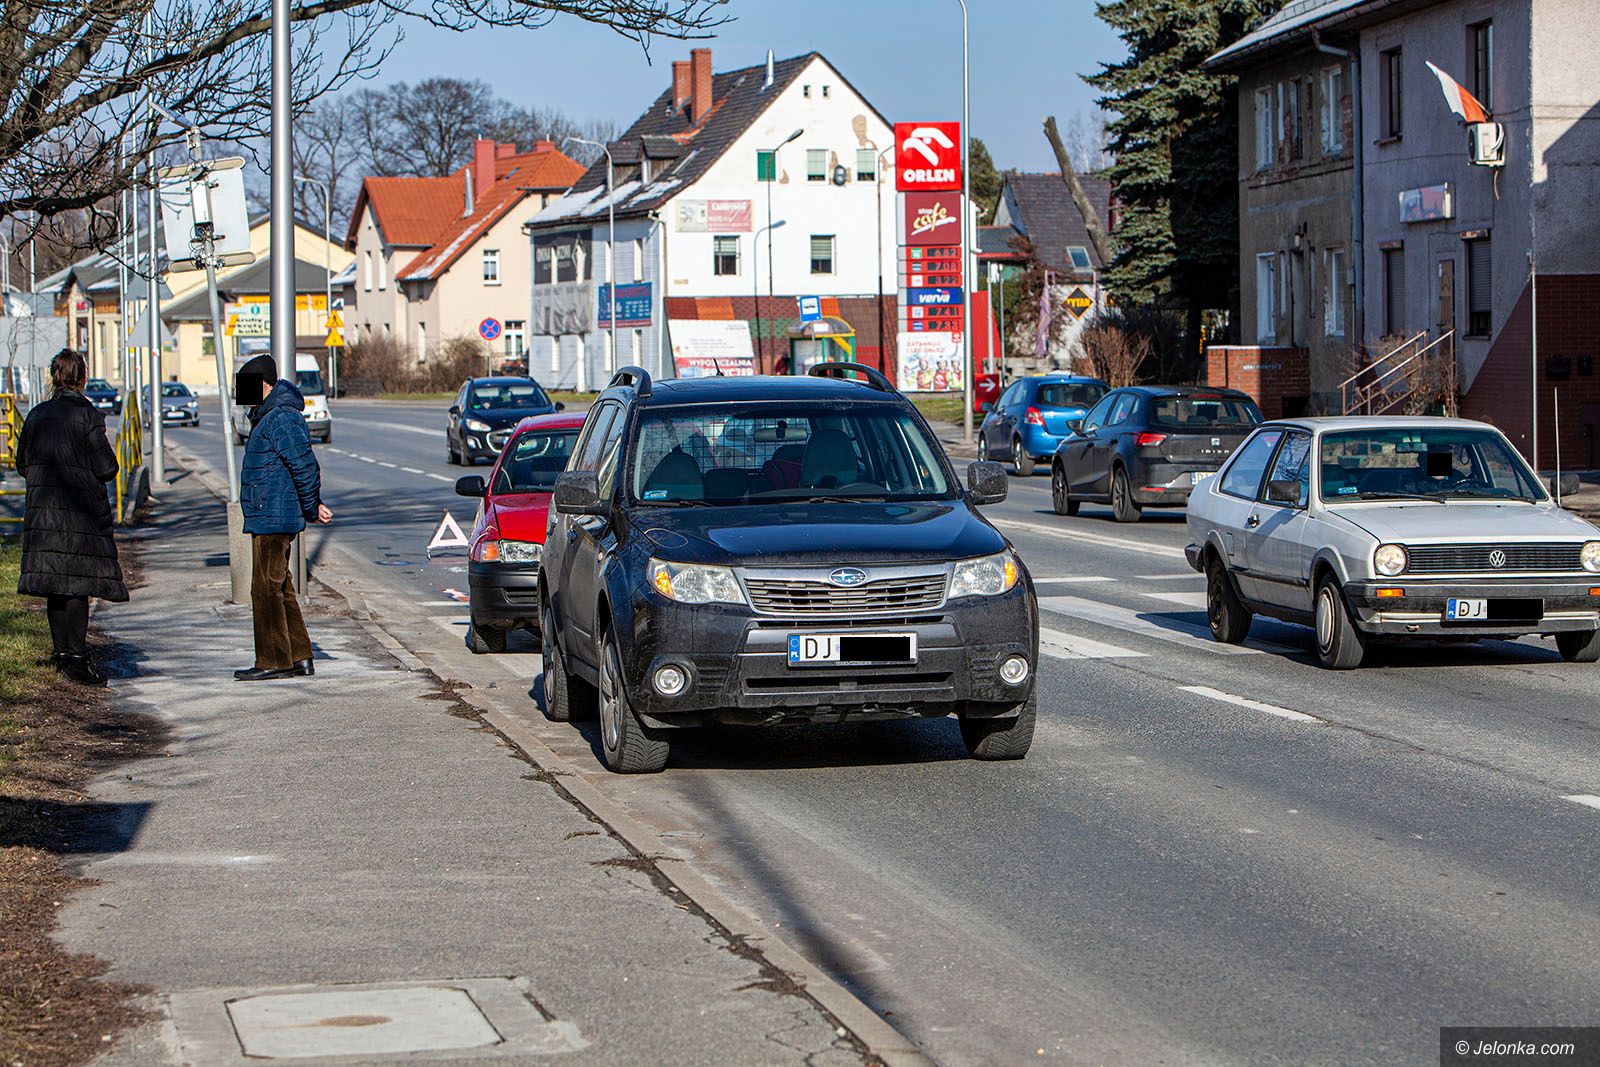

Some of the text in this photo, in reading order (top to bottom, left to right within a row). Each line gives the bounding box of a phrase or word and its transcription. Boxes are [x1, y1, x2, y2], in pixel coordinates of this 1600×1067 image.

[903, 168, 955, 183] ORLEN
[919, 294, 950, 304] verva
[1459, 601, 1482, 617] DJ
[805, 637, 831, 659] DJ
